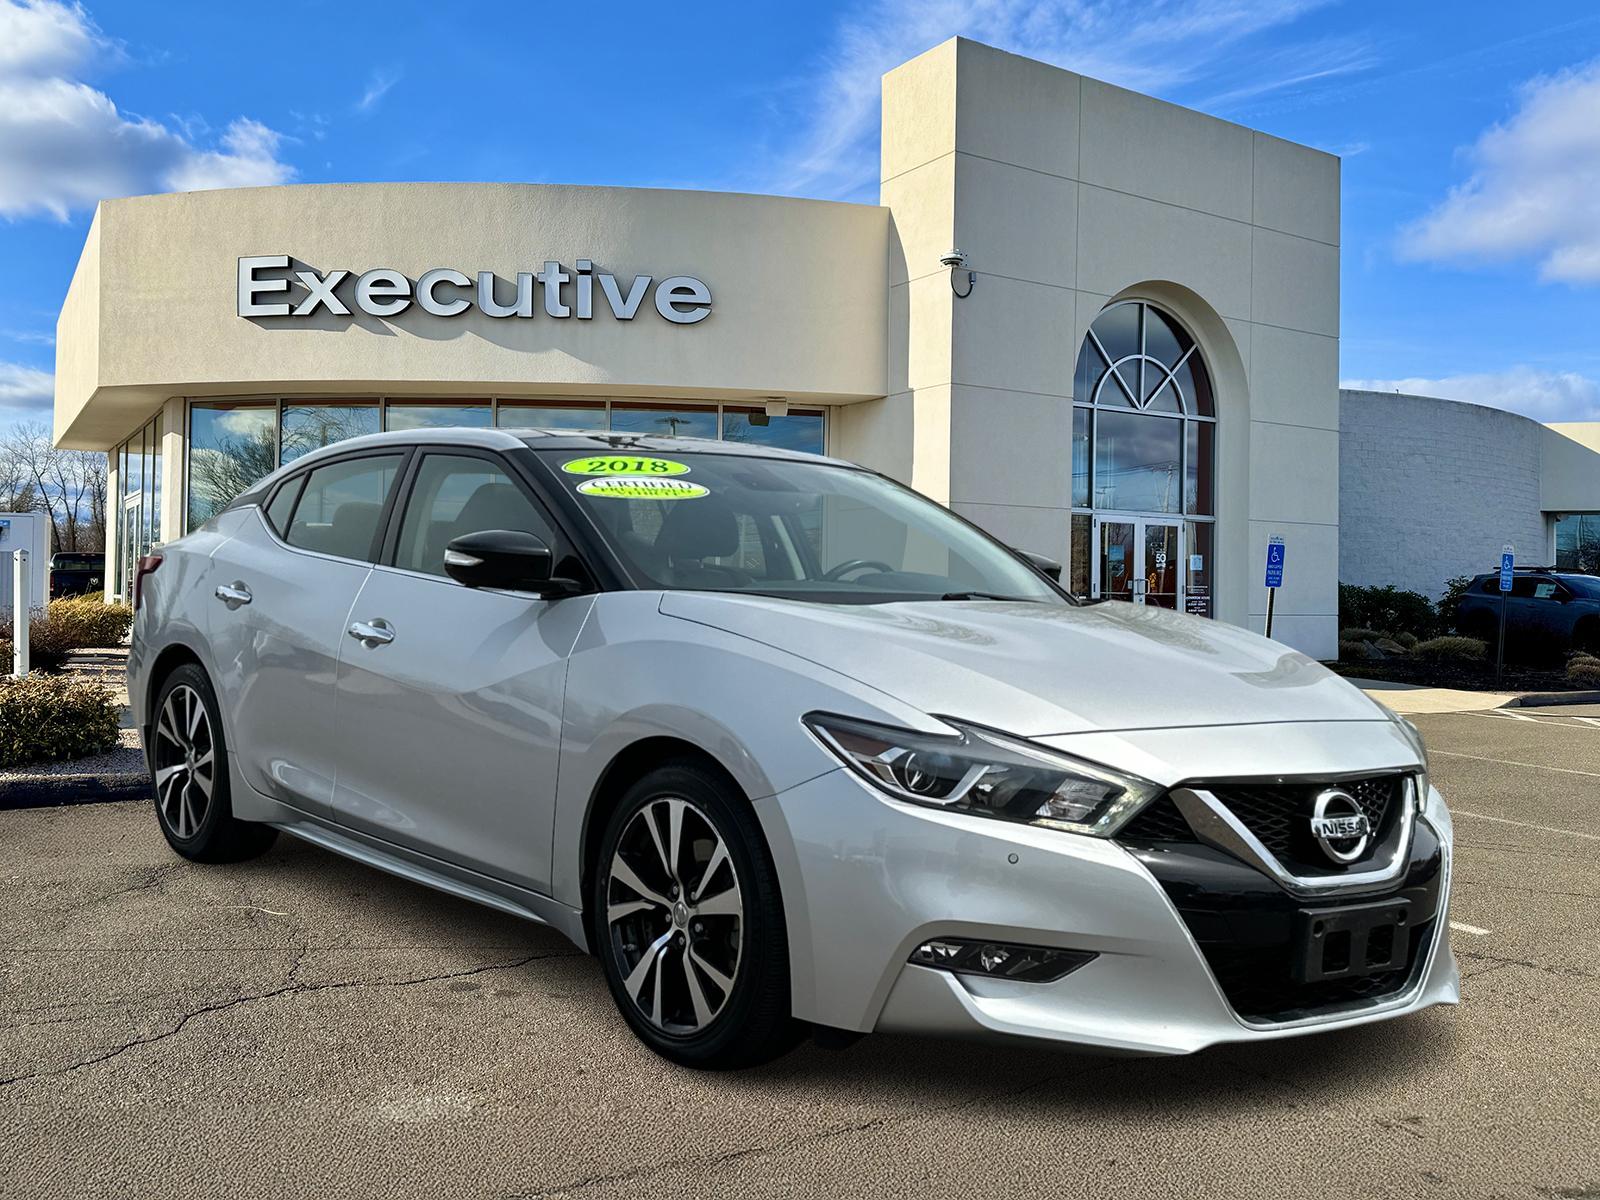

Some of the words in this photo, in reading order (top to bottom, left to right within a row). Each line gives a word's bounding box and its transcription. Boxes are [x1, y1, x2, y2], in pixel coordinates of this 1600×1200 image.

[237, 254, 713, 324] Executive
[588, 460, 669, 473] 2018
[591, 480, 692, 490] CERTIFIED
[1322, 820, 1366, 835] NISSA
